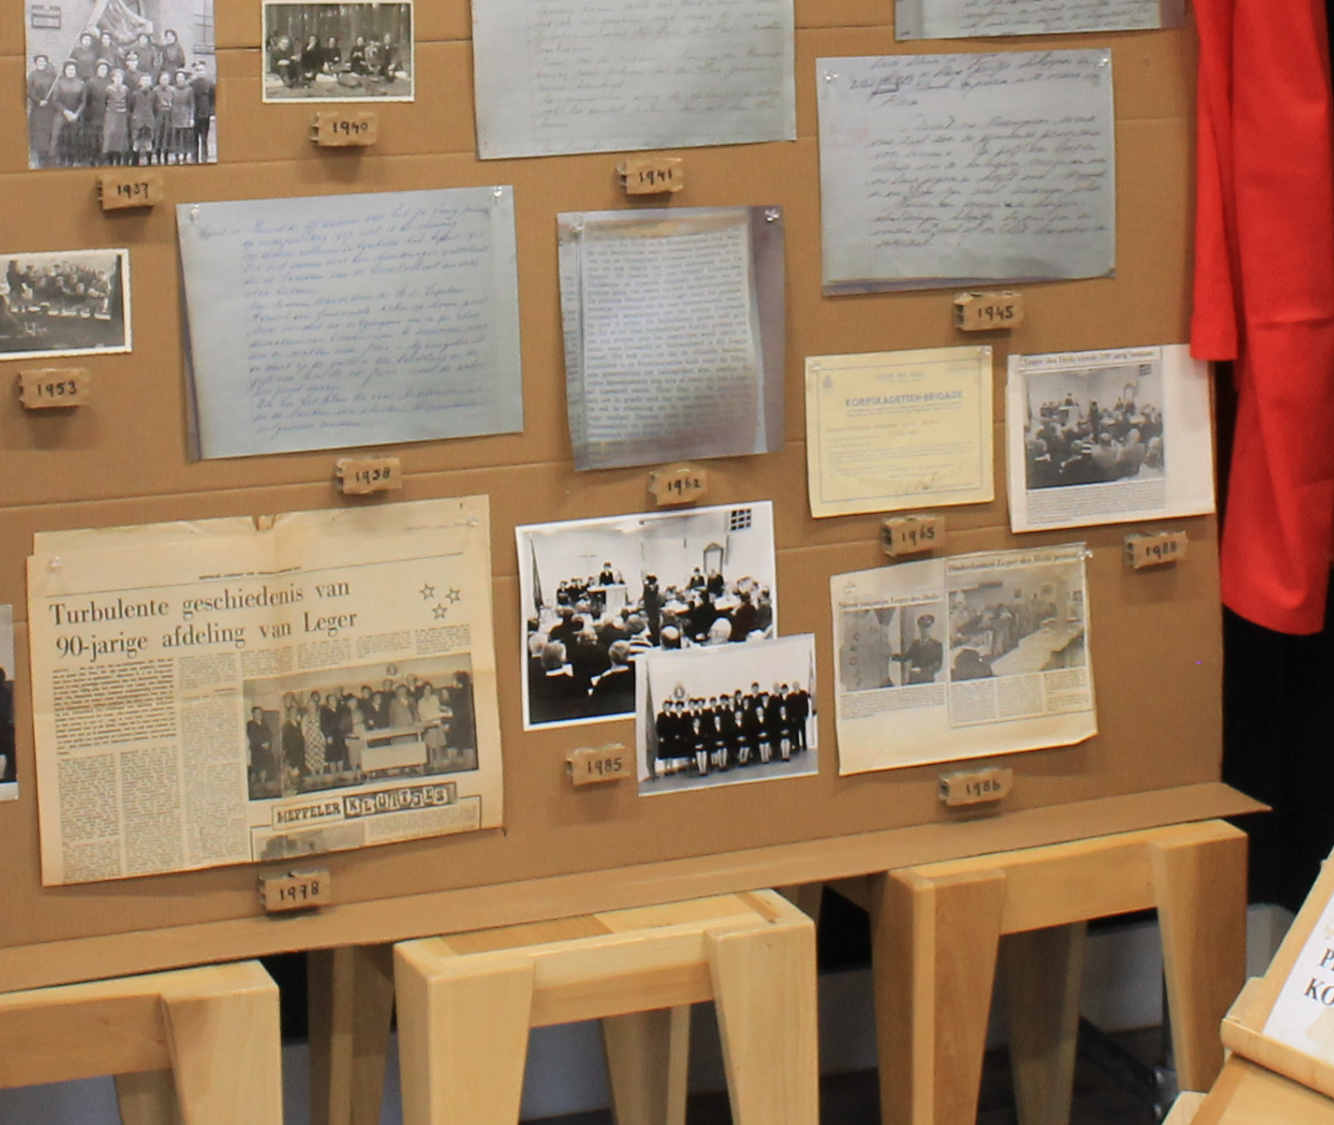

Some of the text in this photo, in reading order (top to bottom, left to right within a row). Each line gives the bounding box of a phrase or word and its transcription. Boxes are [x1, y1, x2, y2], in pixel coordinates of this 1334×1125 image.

[332, 120, 368, 135] 1940
[639, 169, 673, 186] 1941
[116, 182, 149, 200] 1937
[978, 305, 1014, 319] 1945
[36, 381, 78, 396] 1953
[901, 527, 935, 543] 1965
[49, 580, 351, 626] Turbulente geschiedenis van
[56, 609, 357, 662] 90-jarige afdeling van Leger
[587, 756, 623, 775] 1985
[279, 881, 320, 902] 1978
